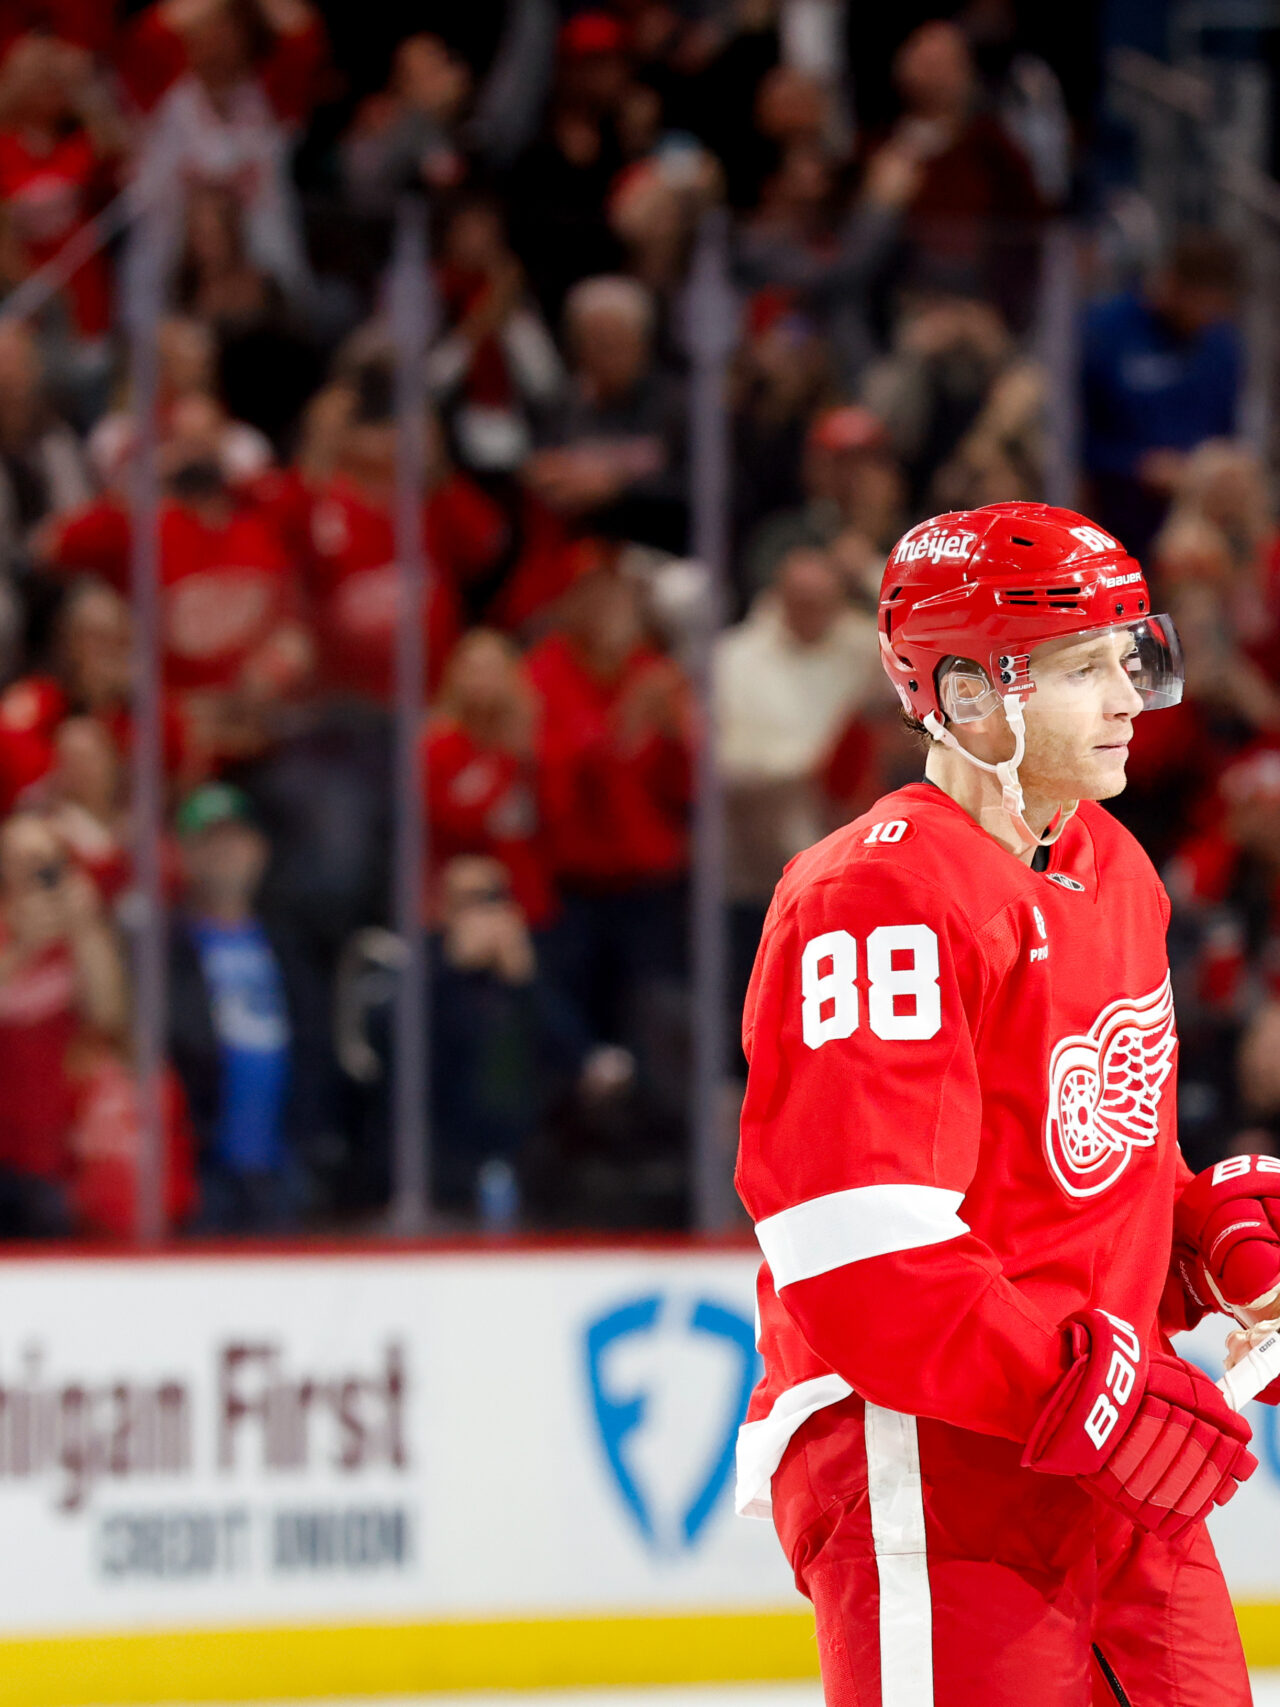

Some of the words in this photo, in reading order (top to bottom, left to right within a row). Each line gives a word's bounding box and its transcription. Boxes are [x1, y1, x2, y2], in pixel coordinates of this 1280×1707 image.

[893, 529, 974, 565] meijer
[863, 819, 909, 845] 10
[801, 923, 942, 1051] 88
[215, 1337, 410, 1472] First
